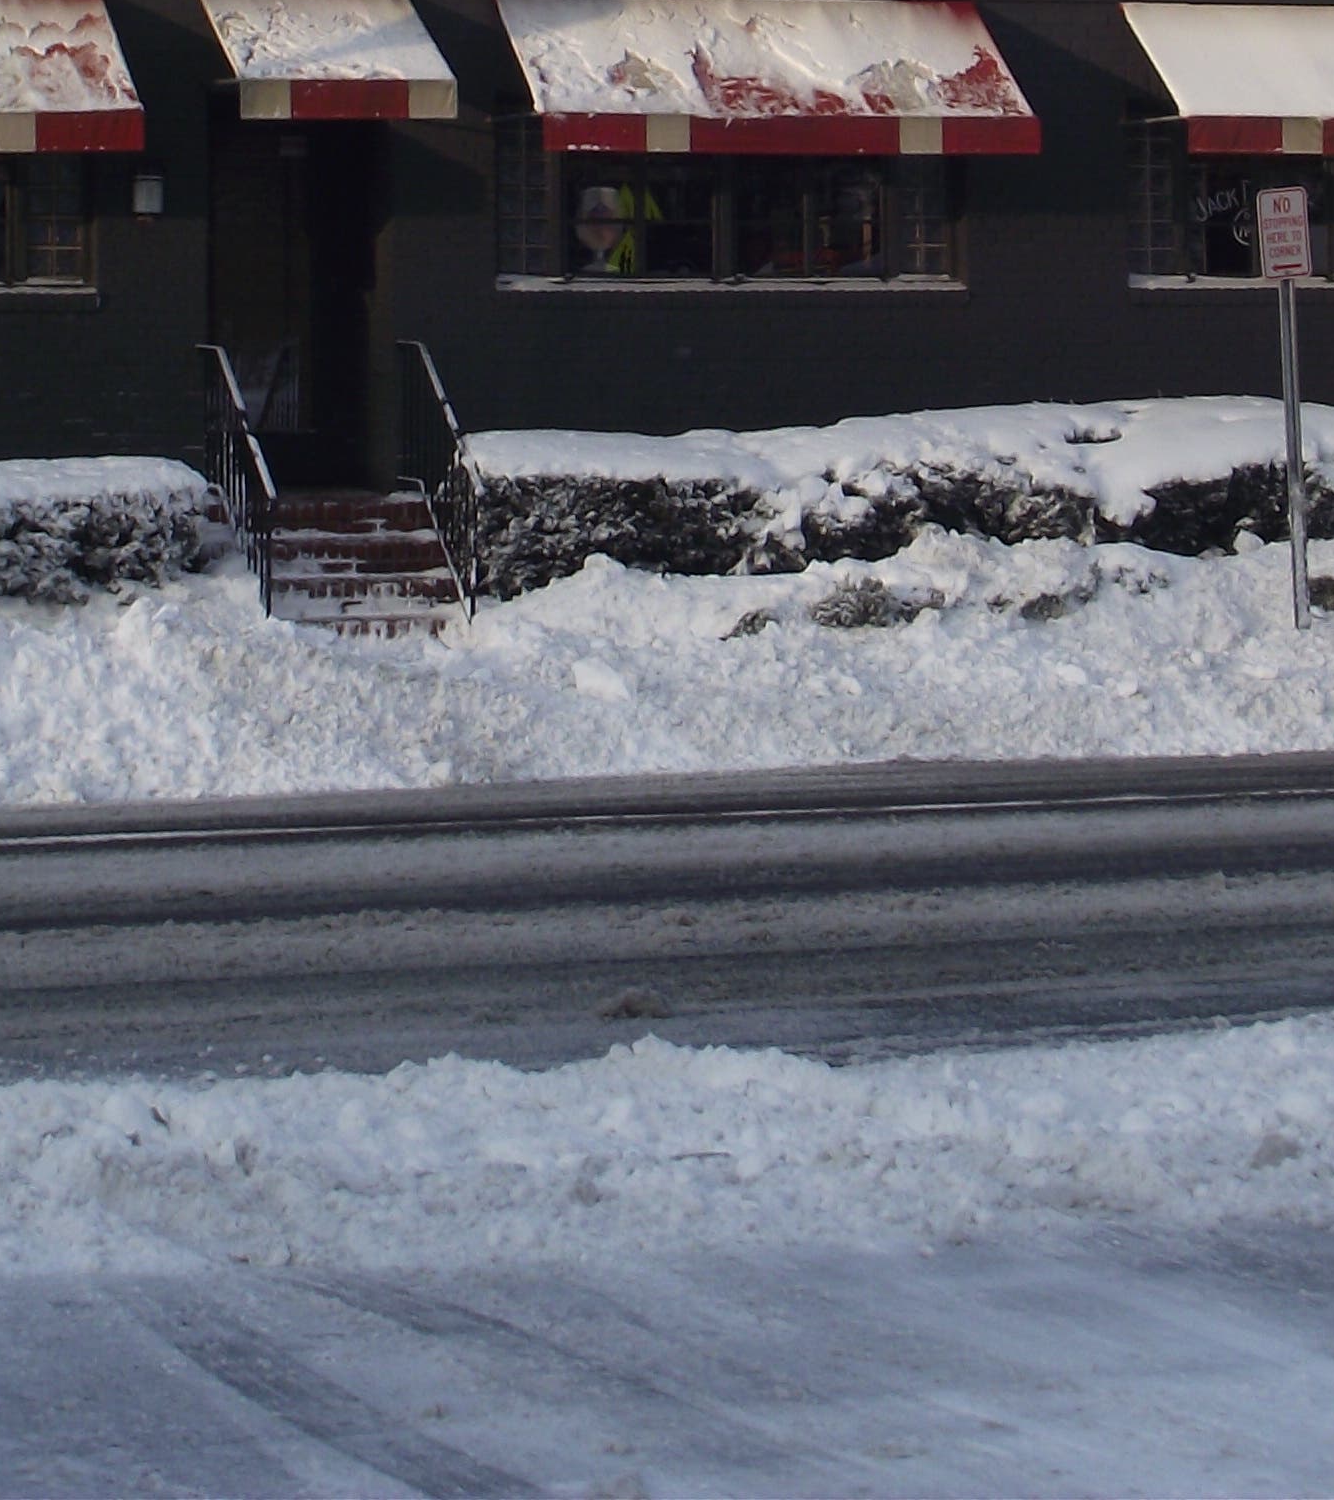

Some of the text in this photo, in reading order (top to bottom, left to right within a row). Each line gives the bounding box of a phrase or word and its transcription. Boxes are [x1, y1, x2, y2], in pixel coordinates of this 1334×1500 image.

[1195, 187, 1241, 223] JACK
[1273, 197, 1292, 213] NO
[1263, 214, 1304, 230] STOPPING
[1265, 231, 1303, 245] HERE TO
[1269, 244, 1302, 260] CORNER
